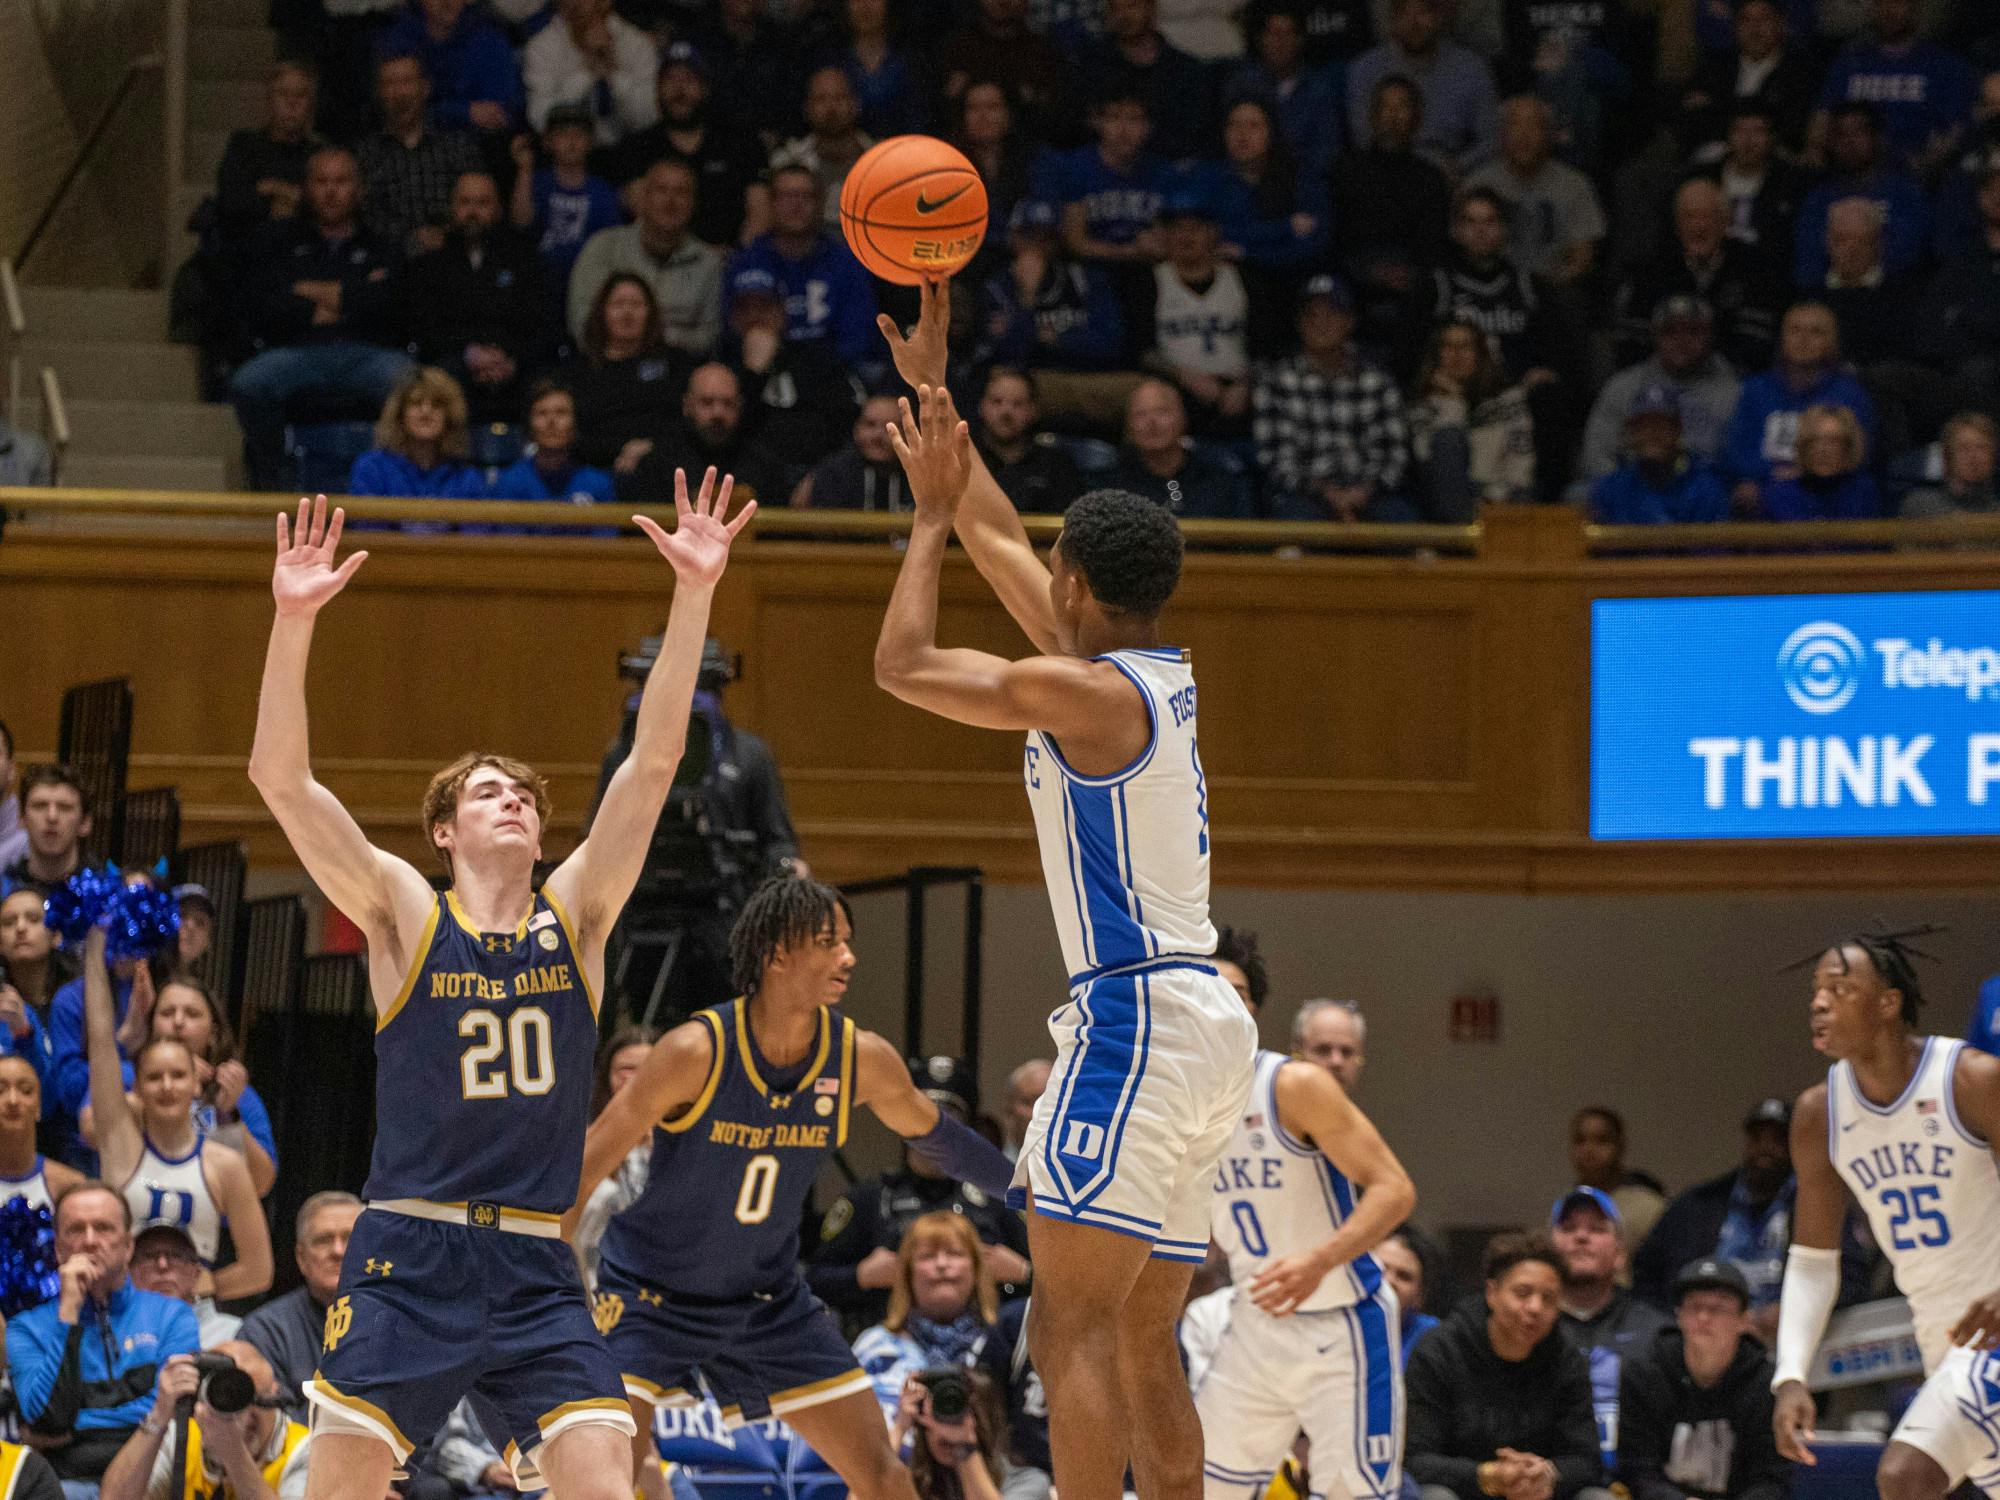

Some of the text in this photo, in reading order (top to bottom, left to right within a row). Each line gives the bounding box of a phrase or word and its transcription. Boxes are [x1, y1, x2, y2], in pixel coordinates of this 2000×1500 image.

[1873, 637, 2000, 701] Telep
[1688, 733, 1936, 807] THINK
[430, 965, 573, 999] NOTRE DAME
[458, 1006, 556, 1099] 20
[709, 1120, 830, 1149] NOTRE DAME
[1061, 1119, 1105, 1160] D
[734, 1154, 780, 1225] 0
[1213, 1157, 1283, 1193] UKE
[1849, 1141, 1954, 1189] DUKE
[1231, 1200, 1269, 1257] 0
[1880, 1184, 1952, 1250] 25
[655, 1402, 736, 1450] UKE
